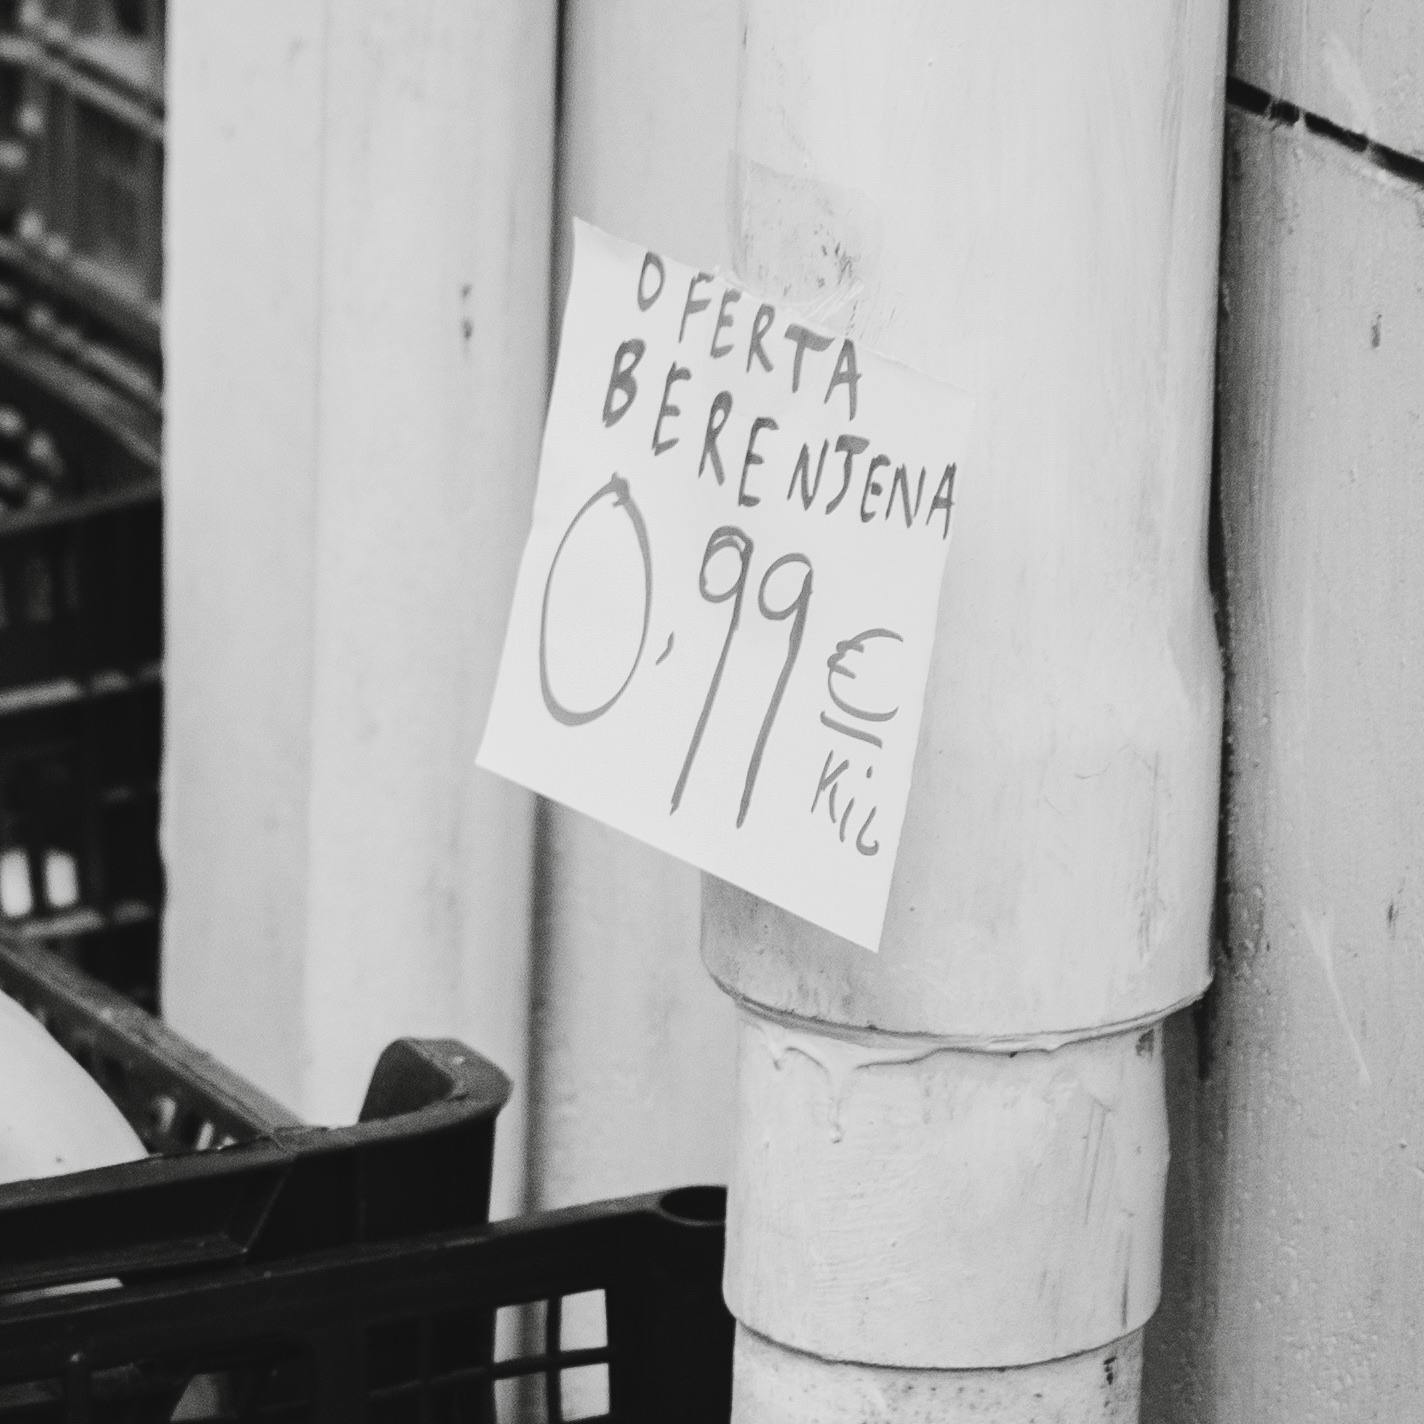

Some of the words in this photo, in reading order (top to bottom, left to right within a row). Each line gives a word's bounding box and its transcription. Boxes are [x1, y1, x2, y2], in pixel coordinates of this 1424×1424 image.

[637, 250, 863, 421] OFERTA
[602, 338, 958, 540] BERENJENA
[539, 472, 814, 828] 0,99
